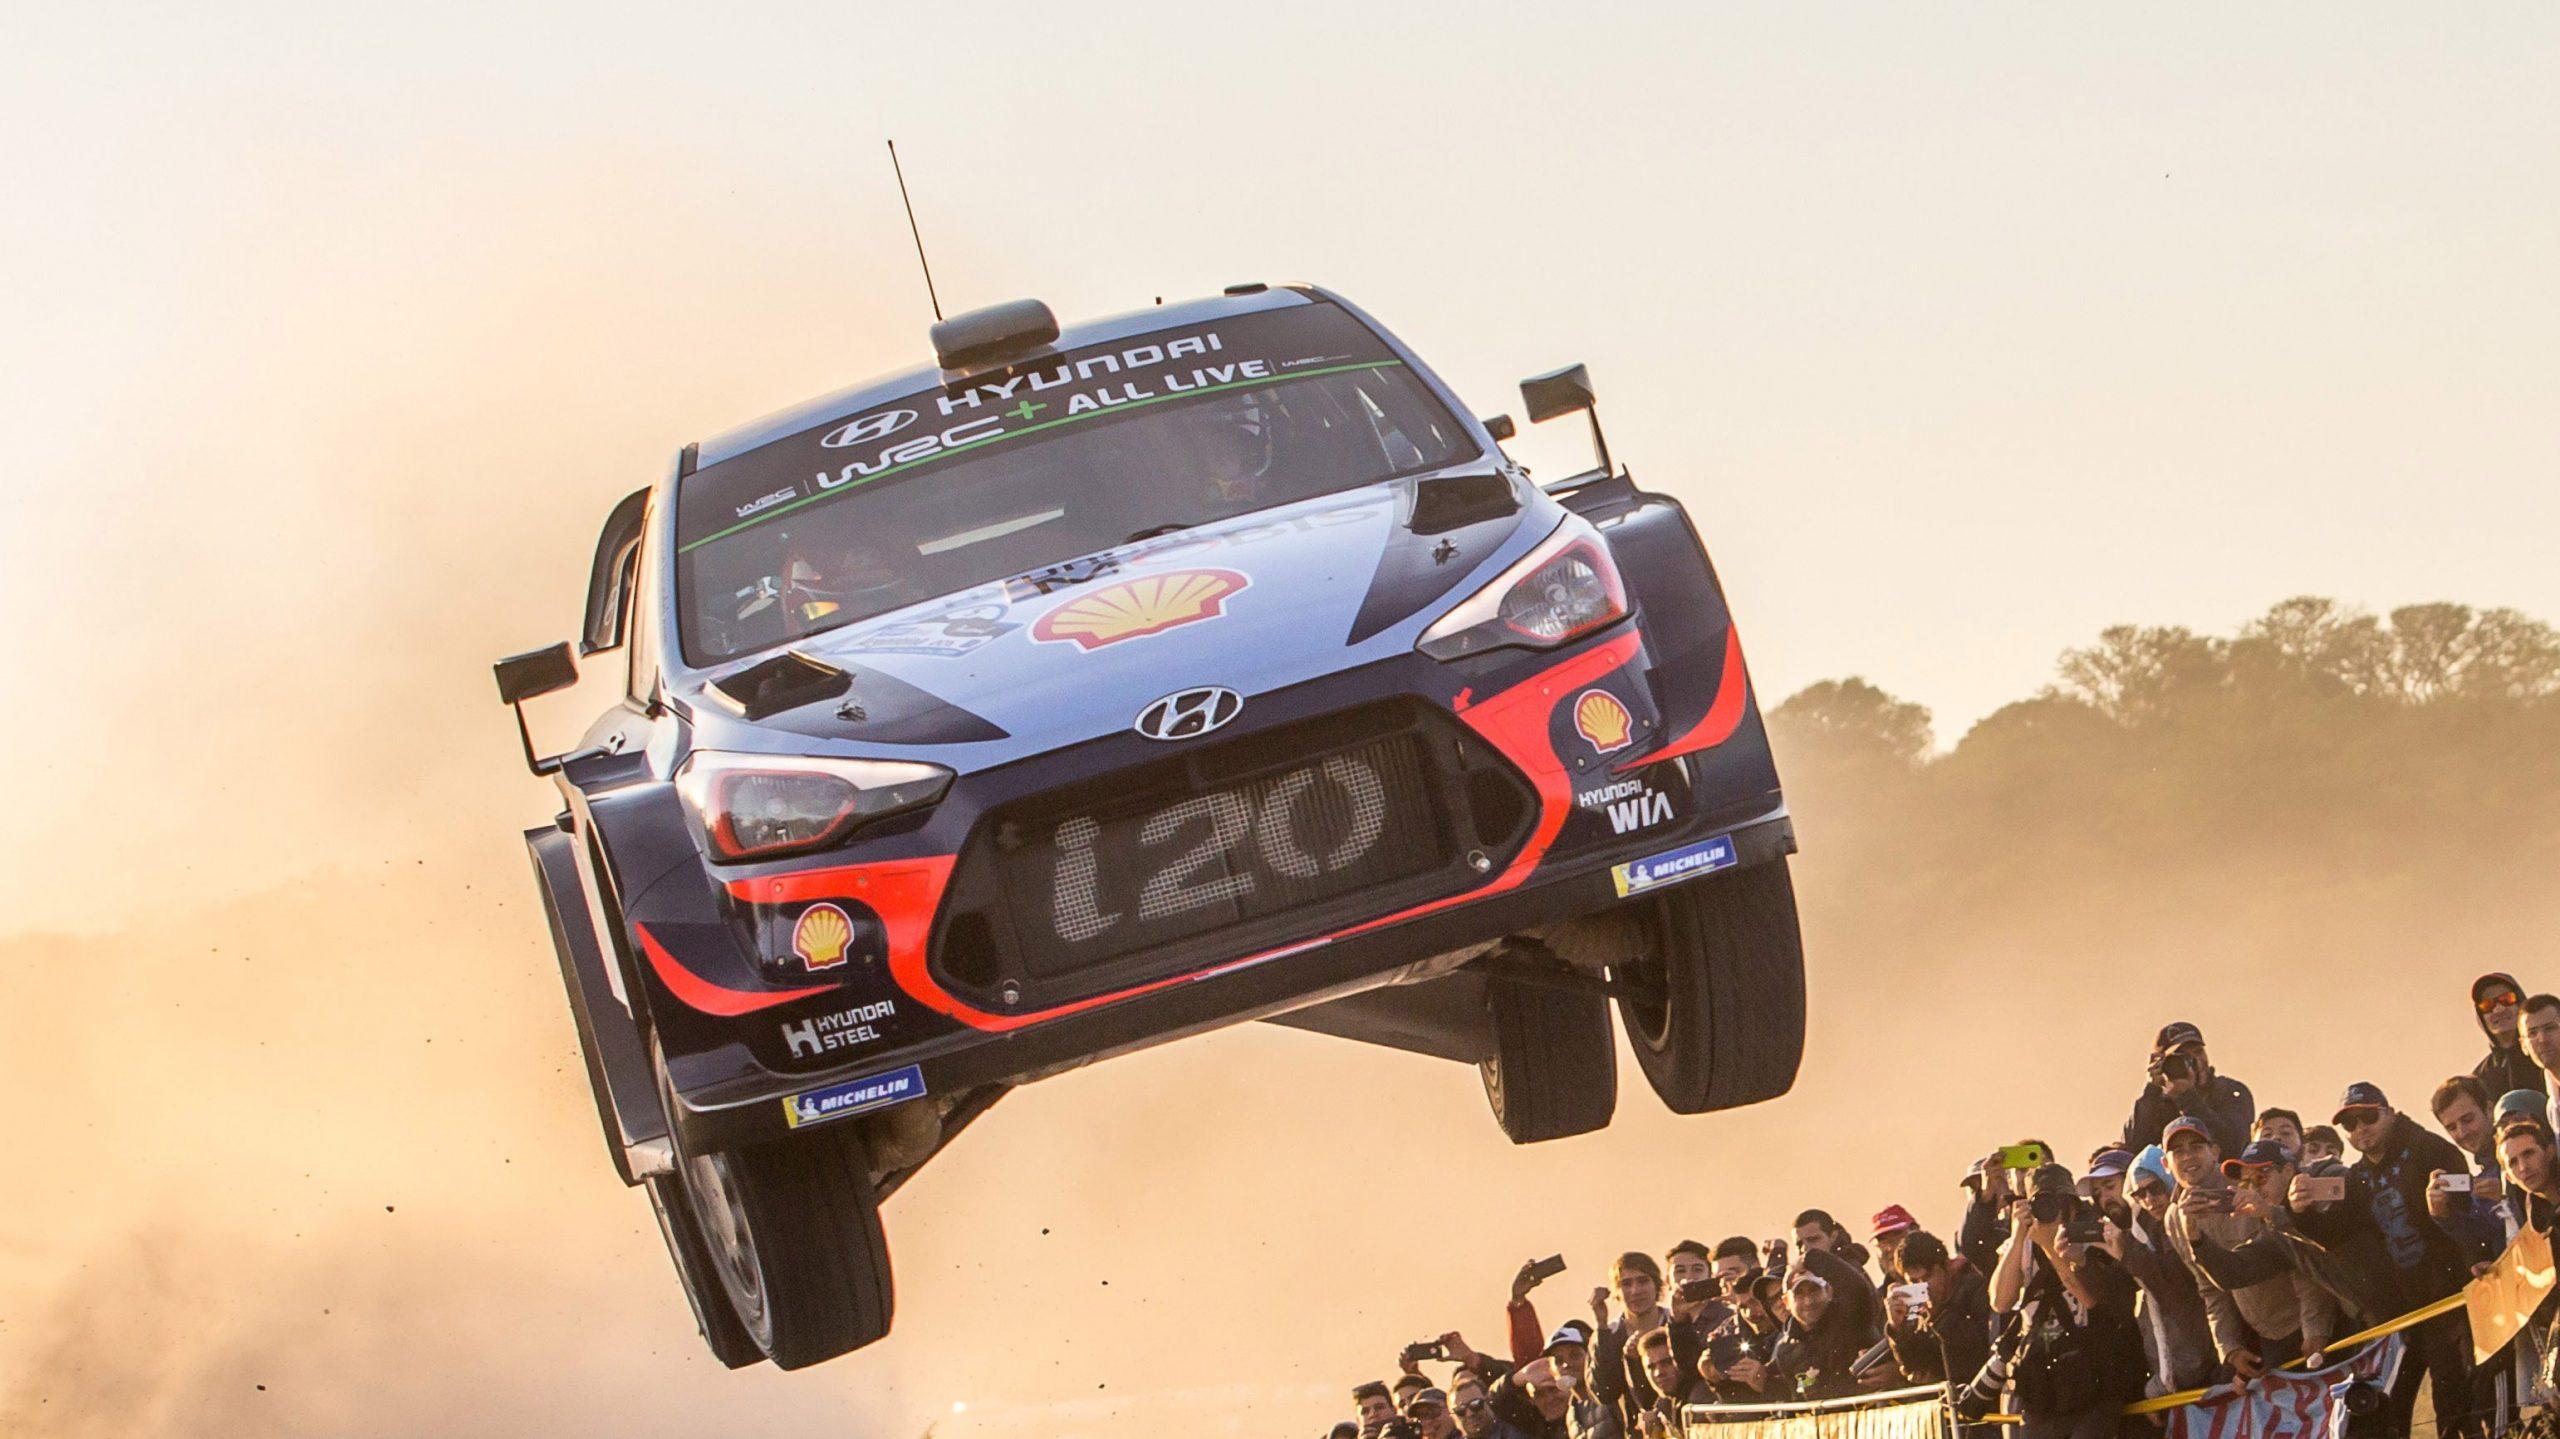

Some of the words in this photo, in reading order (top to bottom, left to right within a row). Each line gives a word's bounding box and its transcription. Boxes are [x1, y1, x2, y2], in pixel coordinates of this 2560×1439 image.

[936, 333, 1222, 416] HYUNDAI
[1068, 382, 1155, 415] ALL
[1164, 359, 1269, 392] LIVE
[1578, 779, 1643, 808] HYUNDAI
[1606, 787, 1674, 835] WIA
[1653, 846, 1726, 878] MICHELIN
[815, 999, 896, 1032] HYUNDAI
[823, 1024, 881, 1050] STEEL
[820, 1077, 909, 1112] MICHELIN
